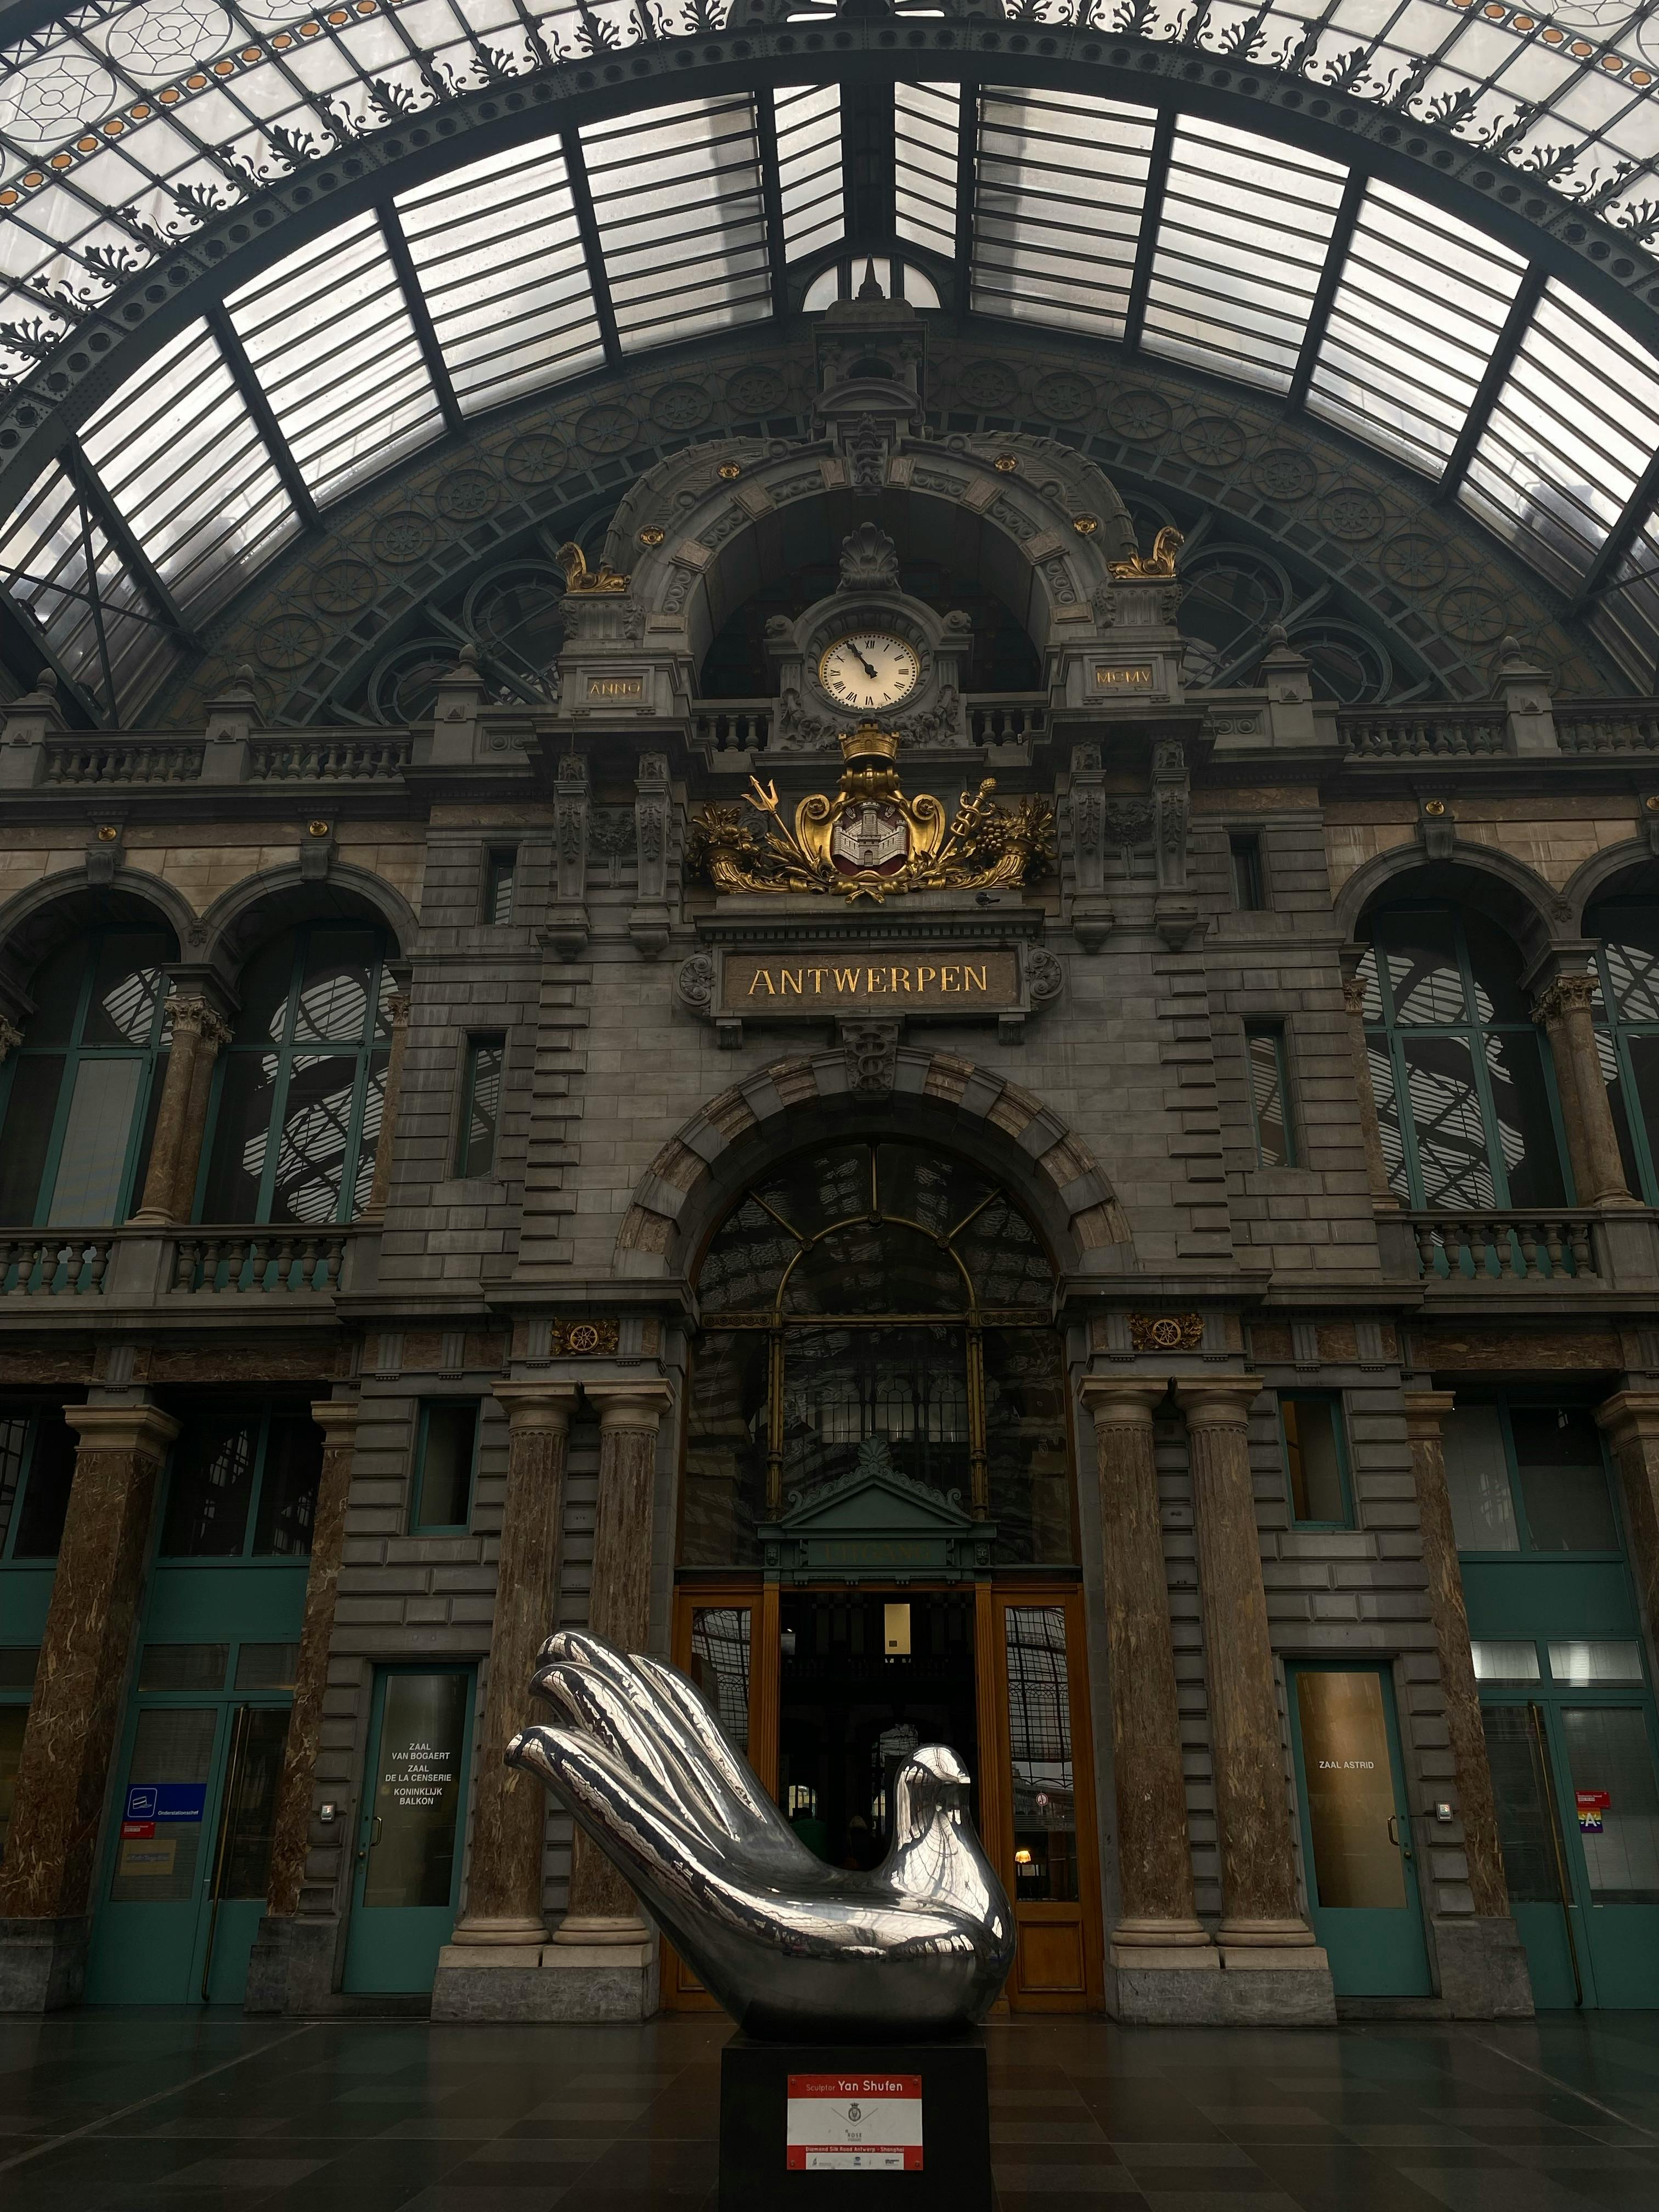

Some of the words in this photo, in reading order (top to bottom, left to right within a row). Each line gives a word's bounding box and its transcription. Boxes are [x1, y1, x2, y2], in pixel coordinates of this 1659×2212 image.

[865, 640, 875, 649] XII
[1097, 671, 1150, 683] MCMV
[590, 683, 640, 695] ANNO
[833, 681, 846, 694] VIII
[894, 681, 905, 691] IV
[845, 691, 857, 703] VII
[865, 696, 873, 706] VI
[747, 964, 988, 995] ANTWERPEN
[1319, 1761, 1342, 1769] ZAAL
[1344, 1761, 1374, 1769] ASTRID
[411, 1774, 452, 1782] CENSERIE
[806, 2084, 836, 2092] Sculptor
[838, 2080, 859, 2091] Yan
[863, 2080, 903, 2091] Shufen
